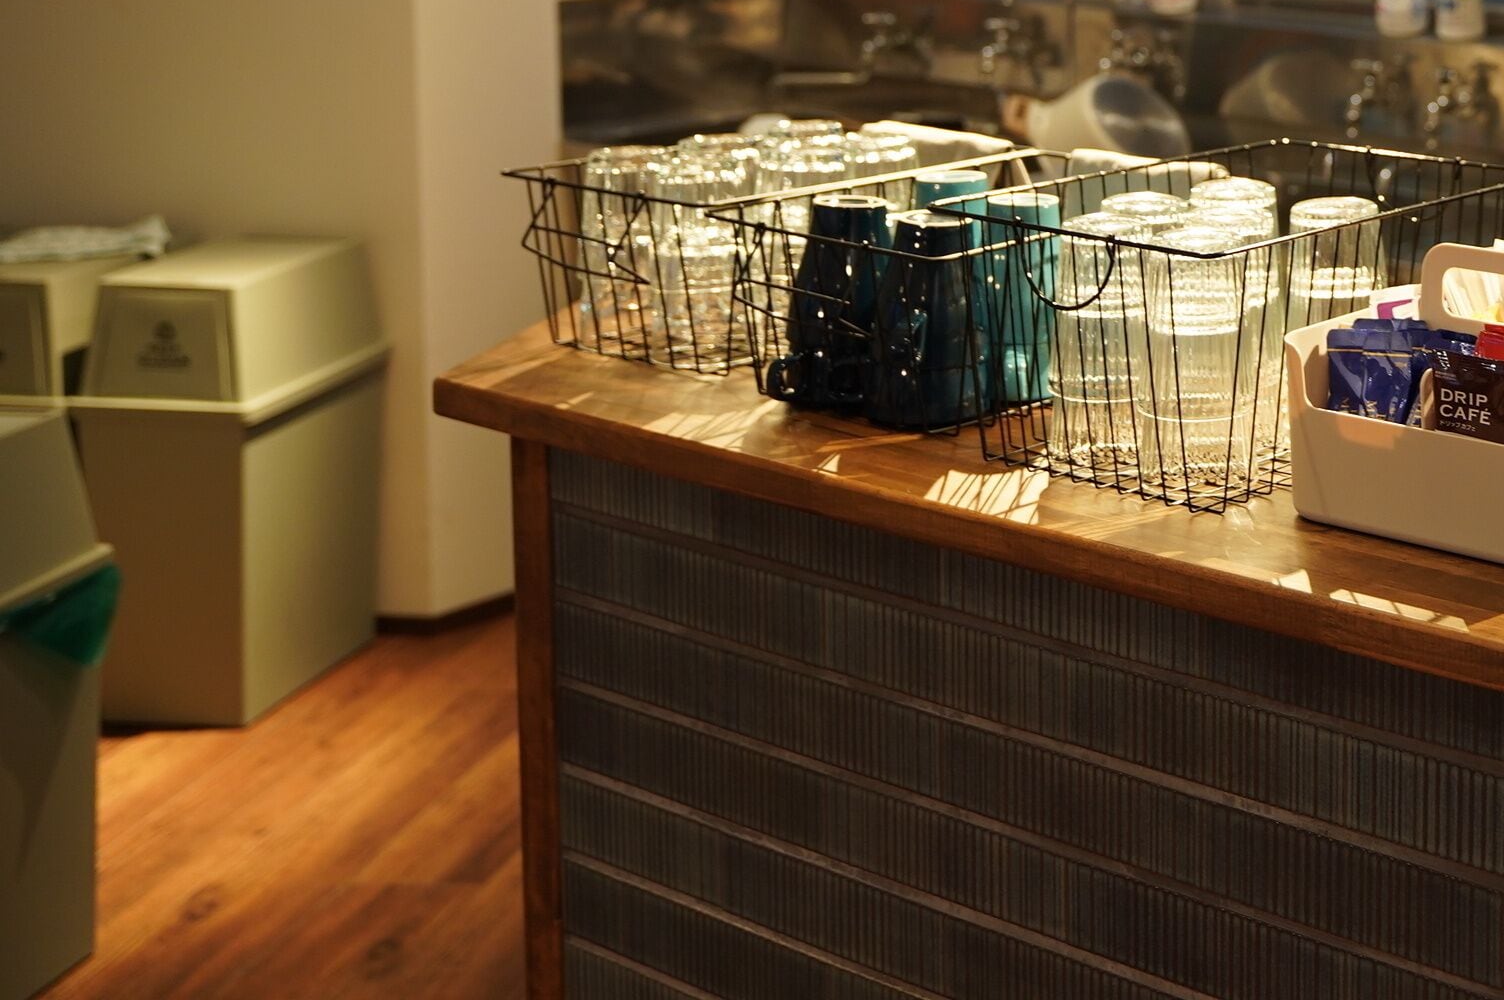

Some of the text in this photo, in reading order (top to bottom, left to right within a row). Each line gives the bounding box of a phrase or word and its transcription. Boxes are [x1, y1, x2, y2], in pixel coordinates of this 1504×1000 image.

[1440, 388, 1488, 407] DRIP
[1440, 404, 1491, 426] CAFÉ
[1440, 420, 1477, 432] ドリップカフェ
